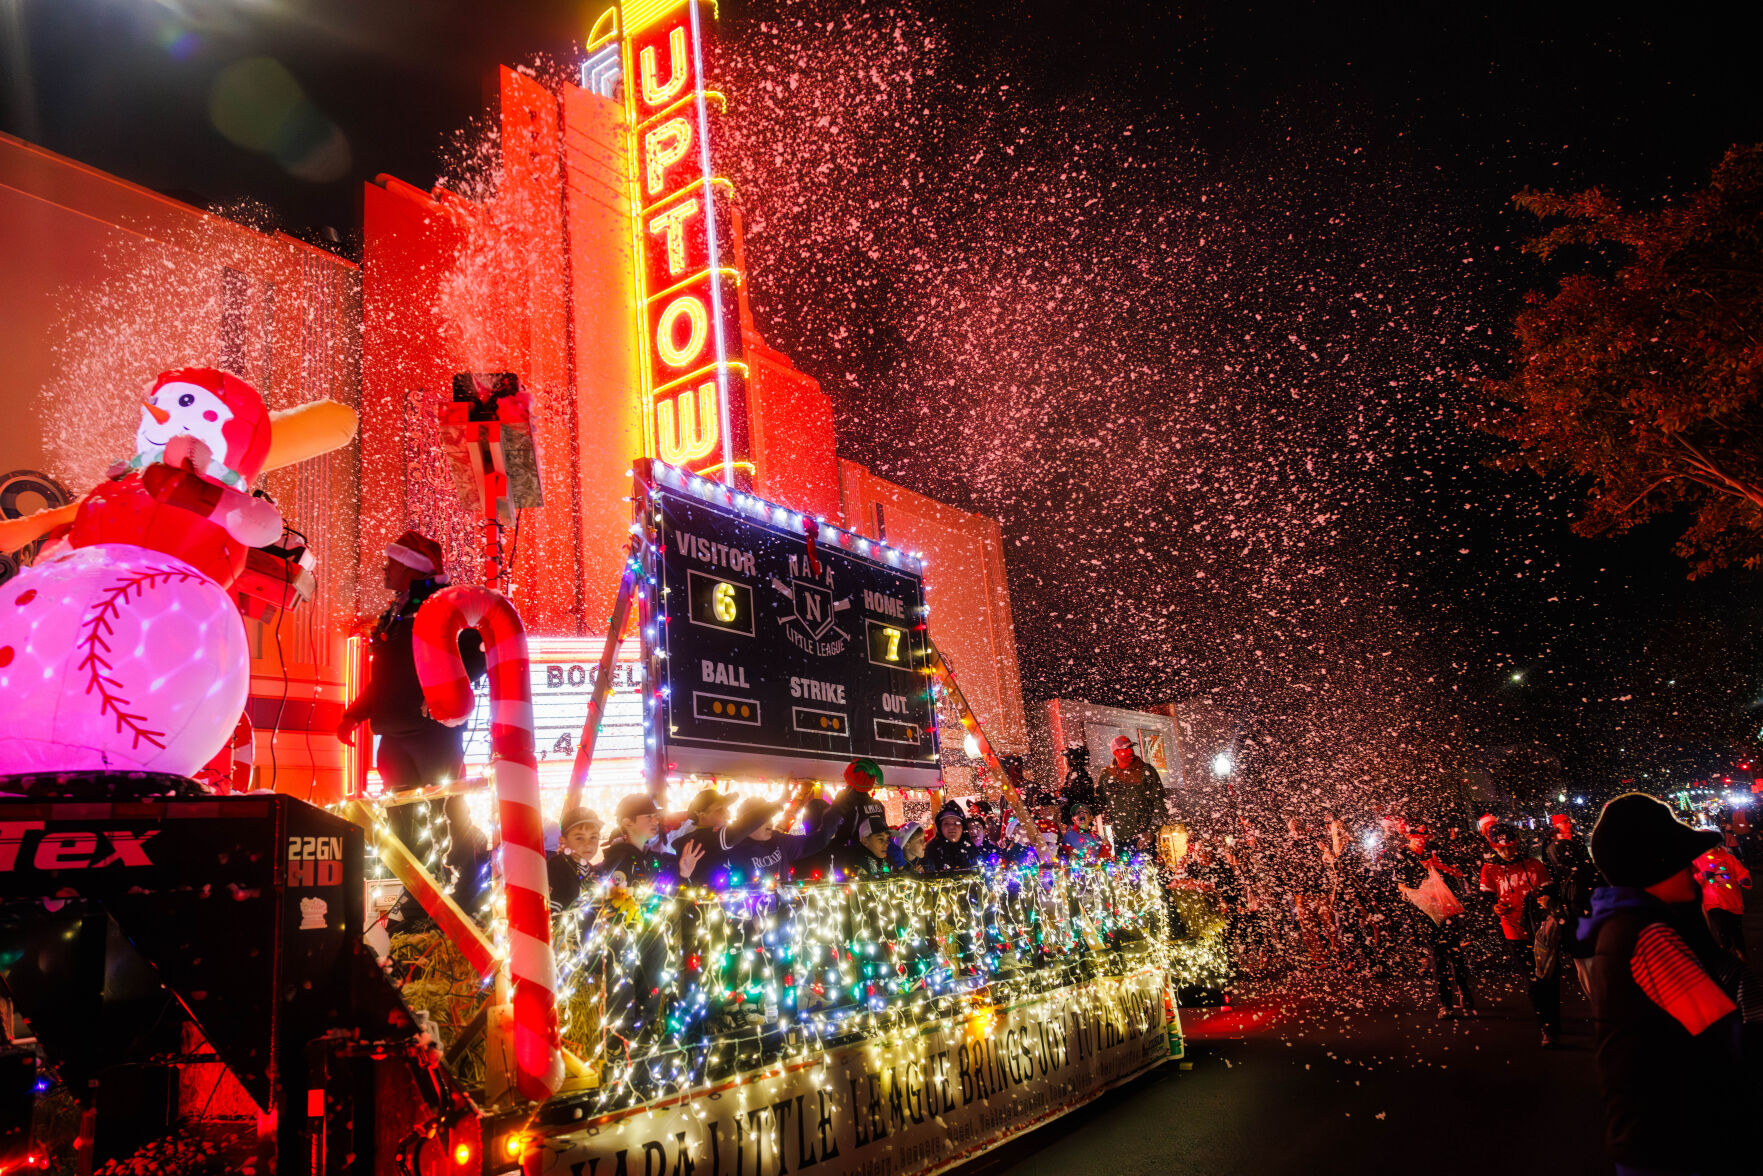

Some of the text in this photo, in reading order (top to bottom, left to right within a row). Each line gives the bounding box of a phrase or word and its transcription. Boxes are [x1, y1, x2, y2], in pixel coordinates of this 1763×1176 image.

[675, 531, 757, 576] VISITOR
[712, 582, 737, 622] 6
[804, 591, 822, 623] N
[863, 589, 904, 619] HOME
[786, 623, 846, 657] LITTLE LEAGUE
[883, 628, 901, 662] 7
[701, 659, 750, 689] BALL
[790, 676, 847, 705] STRIKE
[882, 692, 909, 714] OUT
[288, 836, 343, 861] 22GN
[287, 860, 343, 888] HD
[708, 1086, 840, 1176] LITTLE
[850, 1049, 956, 1149] LEAGUE
[957, 1023, 1034, 1106] BRINGS
[1037, 1002, 1070, 1077] JOY
[1069, 1006, 1094, 1061] TO
